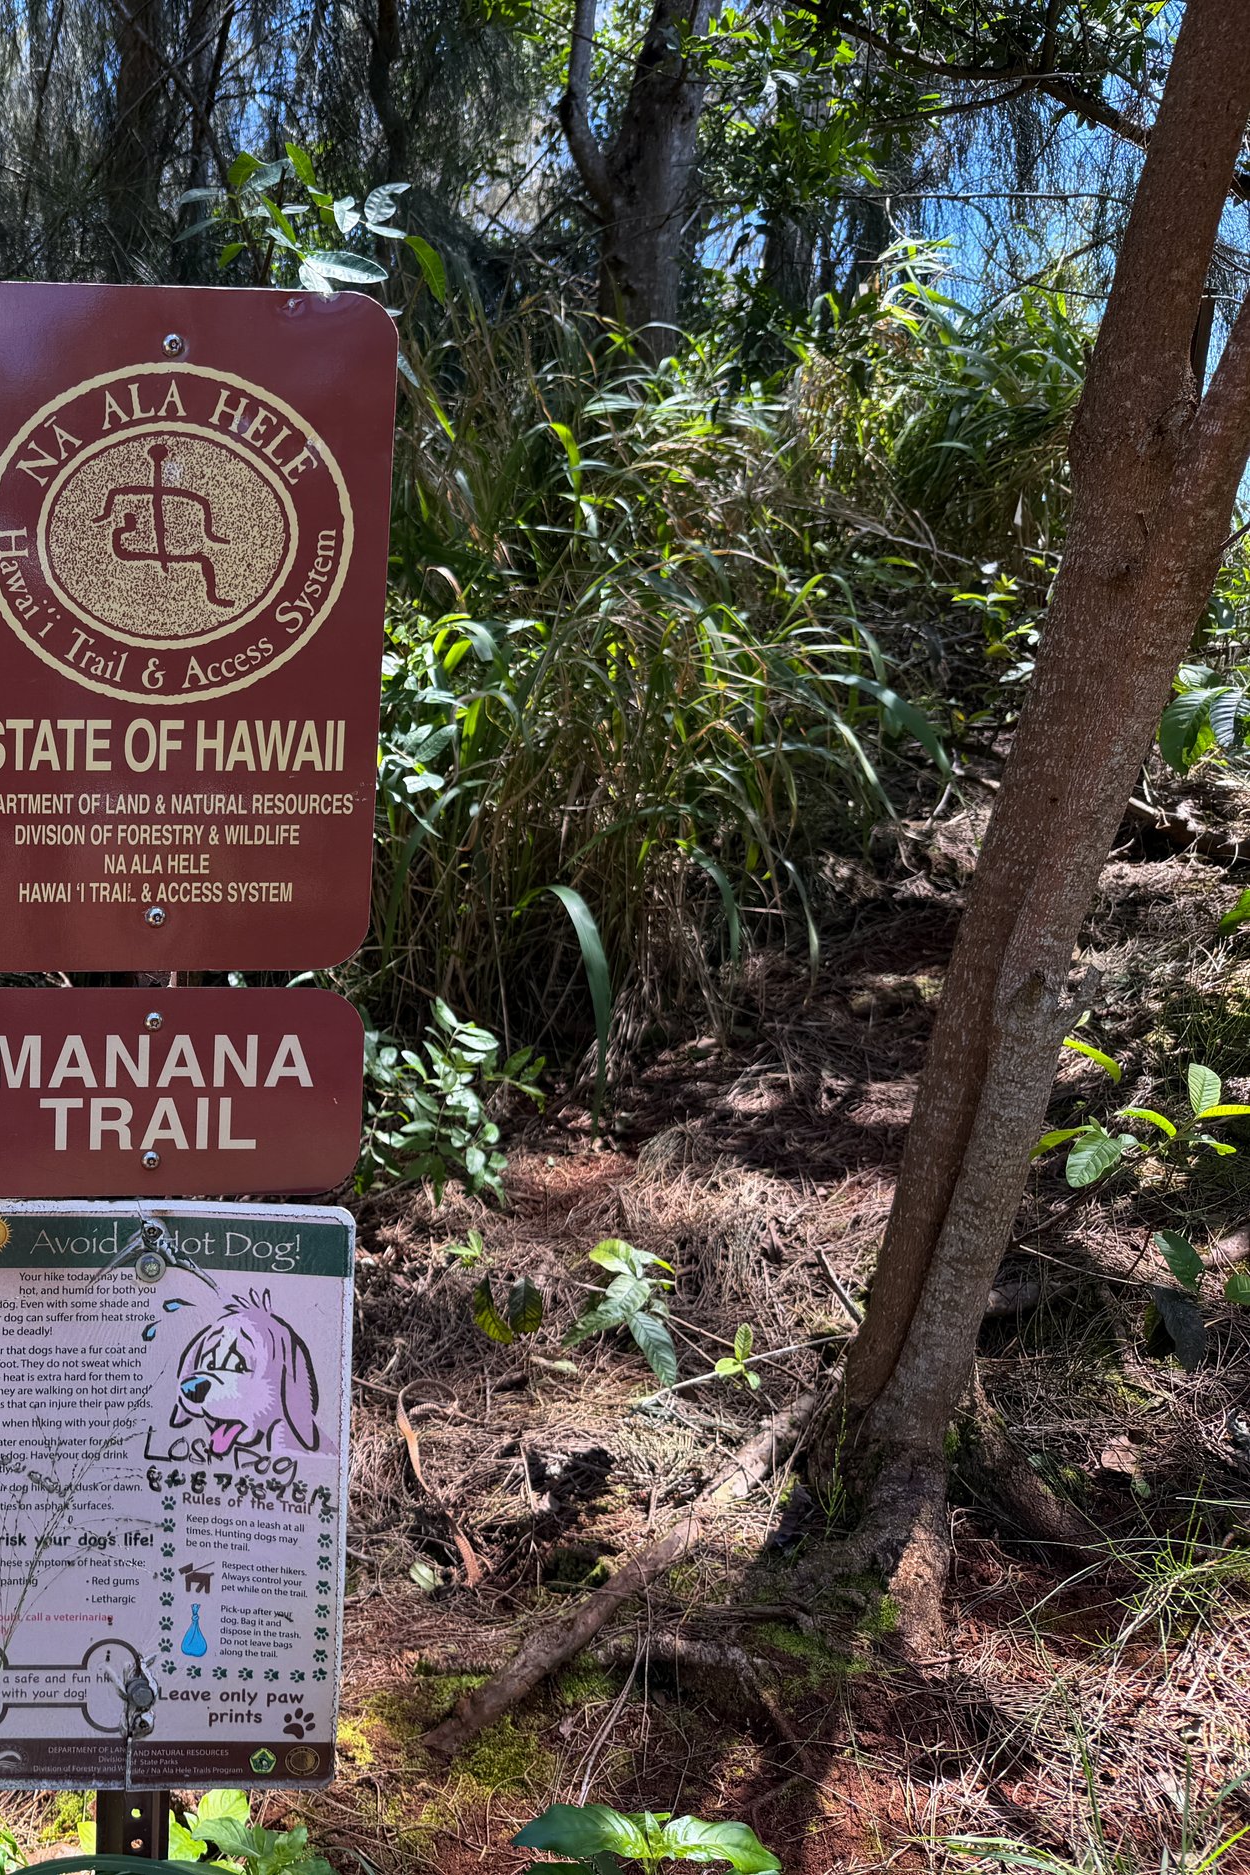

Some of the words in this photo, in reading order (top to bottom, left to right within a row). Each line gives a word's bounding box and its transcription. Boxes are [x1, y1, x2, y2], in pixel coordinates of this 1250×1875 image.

[16, 417, 83, 487] NĀ
[101, 379, 187, 430] ALA
[209, 389, 317, 486] HELE
[63, 627, 129, 682] Trail
[142, 658, 165, 689] &
[182, 637, 274, 690] Access
[274, 528, 337, 634] System
[124, 718, 185, 774] OF
[195, 720, 346, 773] HAWAII
[78, 793, 100, 815] OF
[105, 793, 150, 815] LAND
[155, 794, 165, 815] &
[171, 793, 247, 815] NATURAL
[251, 793, 353, 816] RESOURCES
[14, 824, 86, 845] DIVISION
[91, 824, 113, 845] OF
[118, 824, 202, 845] FORESTRY
[209, 824, 219, 845] &
[225, 824, 300, 845] WILDLIFE
[104, 855, 127, 874] NA
[130, 855, 163, 874] ALA
[167, 855, 210, 874] HELE
[89, 883, 137, 902] TRAIL
[141, 883, 152, 902] &
[156, 883, 222, 902] ACCESS
[227, 882, 293, 902] SYSTEM
[39, 1097, 257, 1150] TRAIL
[30, 1221, 118, 1254] Avoid
[225, 1232, 300, 1272] Dog!
[20, 1272, 42, 1282] Your
[44, 1272, 64, 1282] hike
[67, 1272, 94, 1284] today
[121, 1272, 133, 1281] be
[20, 1286, 38, 1296] hot,
[41, 1286, 59, 1295] and
[62, 1286, 94, 1295] humid
[97, 1285, 109, 1294] for
[113, 1285, 135, 1294] both
[138, 1286, 156, 1296] you
[21, 1300, 43, 1309] Even
[47, 1300, 68, 1308] with
[99, 1299, 128, 1308] shade
[131, 1299, 149, 1308] and
[4, 1314, 23, 1325] dog
[26, 1315, 43, 1323] can
[46, 1312, 73, 1322] suffer
[76, 1313, 98, 1322] from
[102, 1313, 123, 1322] heat
[126, 1313, 155, 1322] stroke
[2, 1327, 15, 1336] be
[18, 1326, 52, 1338] deadly!
[182, 1492, 221, 1506] Rules
[227, 1493, 244, 1508] of
[250, 1498, 274, 1511] the
[281, 1500, 313, 1515] Trail
[187, 1514, 209, 1524] Keep
[211, 1516, 233, 1527] dogs
[257, 1519, 280, 1530] leash
[283, 1522, 292, 1530] at
[294, 1522, 305, 1532] all
[35, 1534, 71, 1550] your
[124, 1533, 154, 1547] life!
[186, 1527, 213, 1536] times.
[215, 1529, 251, 1541] Hunting
[254, 1532, 276, 1544] dogs
[279, 1535, 298, 1547] may
[186, 1539, 197, 1547] be
[200, 1540, 212, 1548] on
[214, 1540, 229, 1549] the
[231, 1542, 250, 1552] trail.
[1, 1578, 38, 1588] panting
[92, 1577, 109, 1585] Red
[113, 1578, 139, 1588] gums
[91, 1595, 136, 1606] Lethargic
[15, 1674, 39, 1683] safe
[45, 1674, 66, 1683] and
[72, 1673, 91, 1683] fun
[2, 1689, 27, 1698] with
[33, 1690, 59, 1701] your
[64, 1688, 87, 1700] dog!
[159, 1686, 211, 1701] Leave
[220, 1689, 258, 1706] only
[267, 1691, 304, 1707] paw
[209, 1709, 262, 1727] prints
